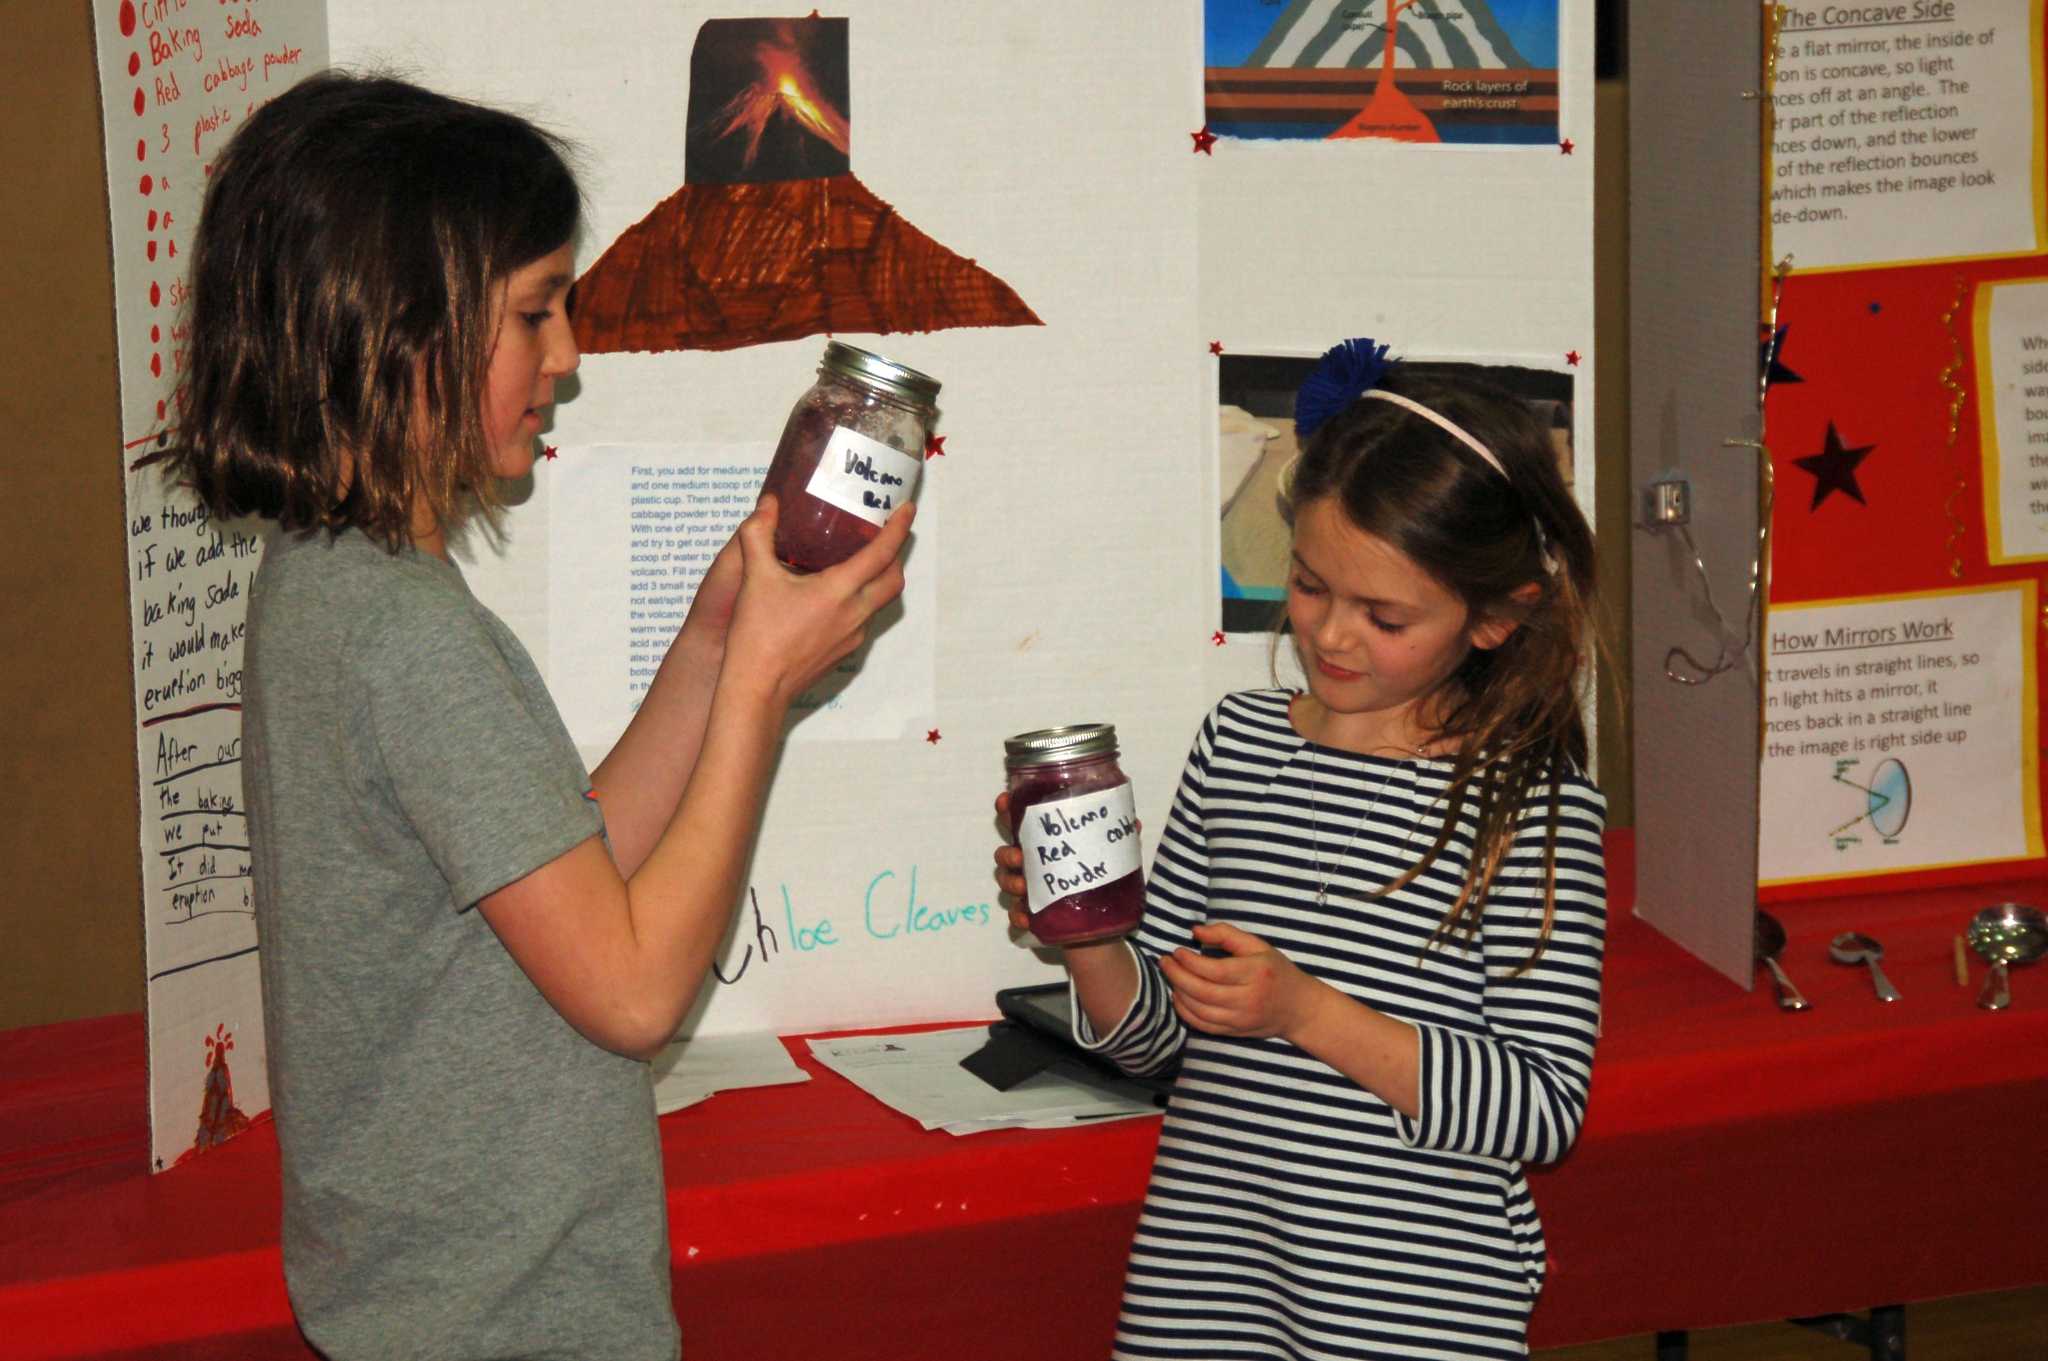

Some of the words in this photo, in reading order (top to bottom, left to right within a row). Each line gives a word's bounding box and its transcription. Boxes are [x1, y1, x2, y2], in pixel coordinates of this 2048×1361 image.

[1781, 9, 1817, 27] The
[1823, 4, 1907, 25] Concave
[1913, 0, 1955, 19] Side
[150, 26, 202, 66] Baking
[225, 10, 262, 38] Soda
[1791, 47, 1799, 58] a
[1804, 40, 1830, 57] flat
[1837, 39, 1890, 55] mirror,
[1895, 36, 1921, 51] the
[1927, 31, 1973, 48] inside
[1978, 28, 1995, 46] of
[155, 72, 181, 105] Red
[204, 57, 255, 91] cabbage
[264, 45, 301, 81] powder
[1805, 65, 1817, 81] is
[1823, 63, 1891, 80] concave,
[1896, 62, 1914, 75] so
[1919, 57, 1954, 77] light
[1443, 80, 1472, 92] Rock
[1476, 80, 1512, 95] layers
[1516, 80, 1528, 91] of
[1772, 93, 1804, 107] nces
[1810, 87, 1832, 103] off
[1837, 89, 1852, 102] at
[1858, 87, 1877, 101] an
[1882, 83, 1930, 106] angle.
[1940, 79, 1969, 94] The
[1443, 98, 1484, 109] earth's
[1485, 98, 1518, 109] crust
[1791, 112, 1823, 132] part
[1829, 109, 1845, 126] of
[1851, 108, 1876, 124] the
[1882, 103, 1958, 122] reflection
[161, 124, 170, 153] 3
[194, 105, 230, 155] plastic
[1772, 140, 1805, 154] nces
[1811, 135, 1860, 152] down,
[1866, 132, 1896, 147] and
[1901, 129, 1927, 144] the
[1932, 126, 1977, 142] lower
[1778, 160, 1792, 177] of
[1799, 158, 1824, 175] the
[1830, 154, 1905, 173] reflection
[1911, 150, 1978, 167] bounces
[1771, 184, 1816, 200] which
[1822, 179, 1872, 197] makes
[1876, 177, 1903, 194] the
[1908, 173, 1955, 194] image
[1961, 170, 1995, 186] look
[1772, 206, 1848, 224] de-down.
[658, 468, 674, 477] you
[678, 466, 695, 475] add
[698, 466, 709, 475] for
[713, 466, 749, 475] medium
[844, 448, 903, 486] Volcano
[632, 481, 649, 490] and
[651, 482, 669, 490] one
[672, 481, 709, 490] medium
[712, 481, 740, 491] scoop
[743, 480, 752, 488] of
[632, 496, 661, 505] plastic
[687, 495, 710, 503] Then
[712, 495, 730, 503] add
[863, 491, 891, 509] Red
[132, 515, 151, 536] we
[161, 504, 208, 536] thoug
[632, 511, 671, 520] cabbage
[674, 510, 708, 519] powder
[712, 510, 720, 518] to
[723, 509, 740, 517] that
[631, 524, 652, 532] With
[675, 524, 684, 532] of
[687, 525, 707, 534] your
[166, 547, 186, 572] we
[197, 532, 224, 566] add
[231, 533, 257, 558] the
[631, 555, 658, 563] scoop
[662, 553, 670, 561] of
[651, 540, 662, 549] try
[677, 539, 692, 548] get
[631, 582, 648, 590] add
[651, 582, 656, 590] 3
[660, 582, 684, 590] small
[673, 568, 686, 576] Fill
[205, 570, 239, 609] soda
[631, 596, 645, 604] not
[631, 611, 645, 619] the
[142, 640, 153, 670] it
[169, 623, 204, 662] would
[210, 622, 244, 650] make
[1772, 632, 1817, 651] How
[1826, 625, 1896, 646] Mirrors
[1904, 618, 1953, 638] Work
[630, 668, 656, 676] botto
[1778, 664, 1830, 681] travels
[1836, 663, 1849, 677] in
[1855, 656, 1912, 678] straight
[1918, 654, 1956, 672] lines,
[1962, 652, 1979, 664] so
[144, 668, 205, 710] eruption
[217, 661, 242, 698] bigg
[1784, 690, 1817, 709] light
[1824, 688, 1852, 703] hits
[1857, 689, 1865, 701] a
[1871, 684, 1922, 699] mirror,
[1928, 680, 1937, 694] it
[1766, 718, 1800, 732] nces
[1807, 713, 1843, 729] back
[1849, 712, 1862, 726] in
[1867, 713, 1875, 725] a
[1881, 705, 1939, 726] straight
[1944, 702, 1971, 717] line
[157, 732, 197, 777] After
[217, 738, 241, 762] our
[1768, 742, 1795, 757] the
[1800, 738, 1848, 760] image
[1854, 736, 1865, 750] is
[1870, 733, 1905, 754] right
[1911, 729, 1942, 745] side
[1947, 729, 1967, 746] up
[160, 787, 180, 809] the
[165, 824, 182, 843] we
[202, 822, 223, 846] put
[1040, 806, 1108, 836] Volcano
[1037, 841, 1076, 865] Red
[1107, 815, 1136, 843] cabb
[168, 857, 184, 880] It
[200, 856, 216, 875] did
[172, 885, 215, 919] eruption
[865, 864, 990, 939] Cleaves
